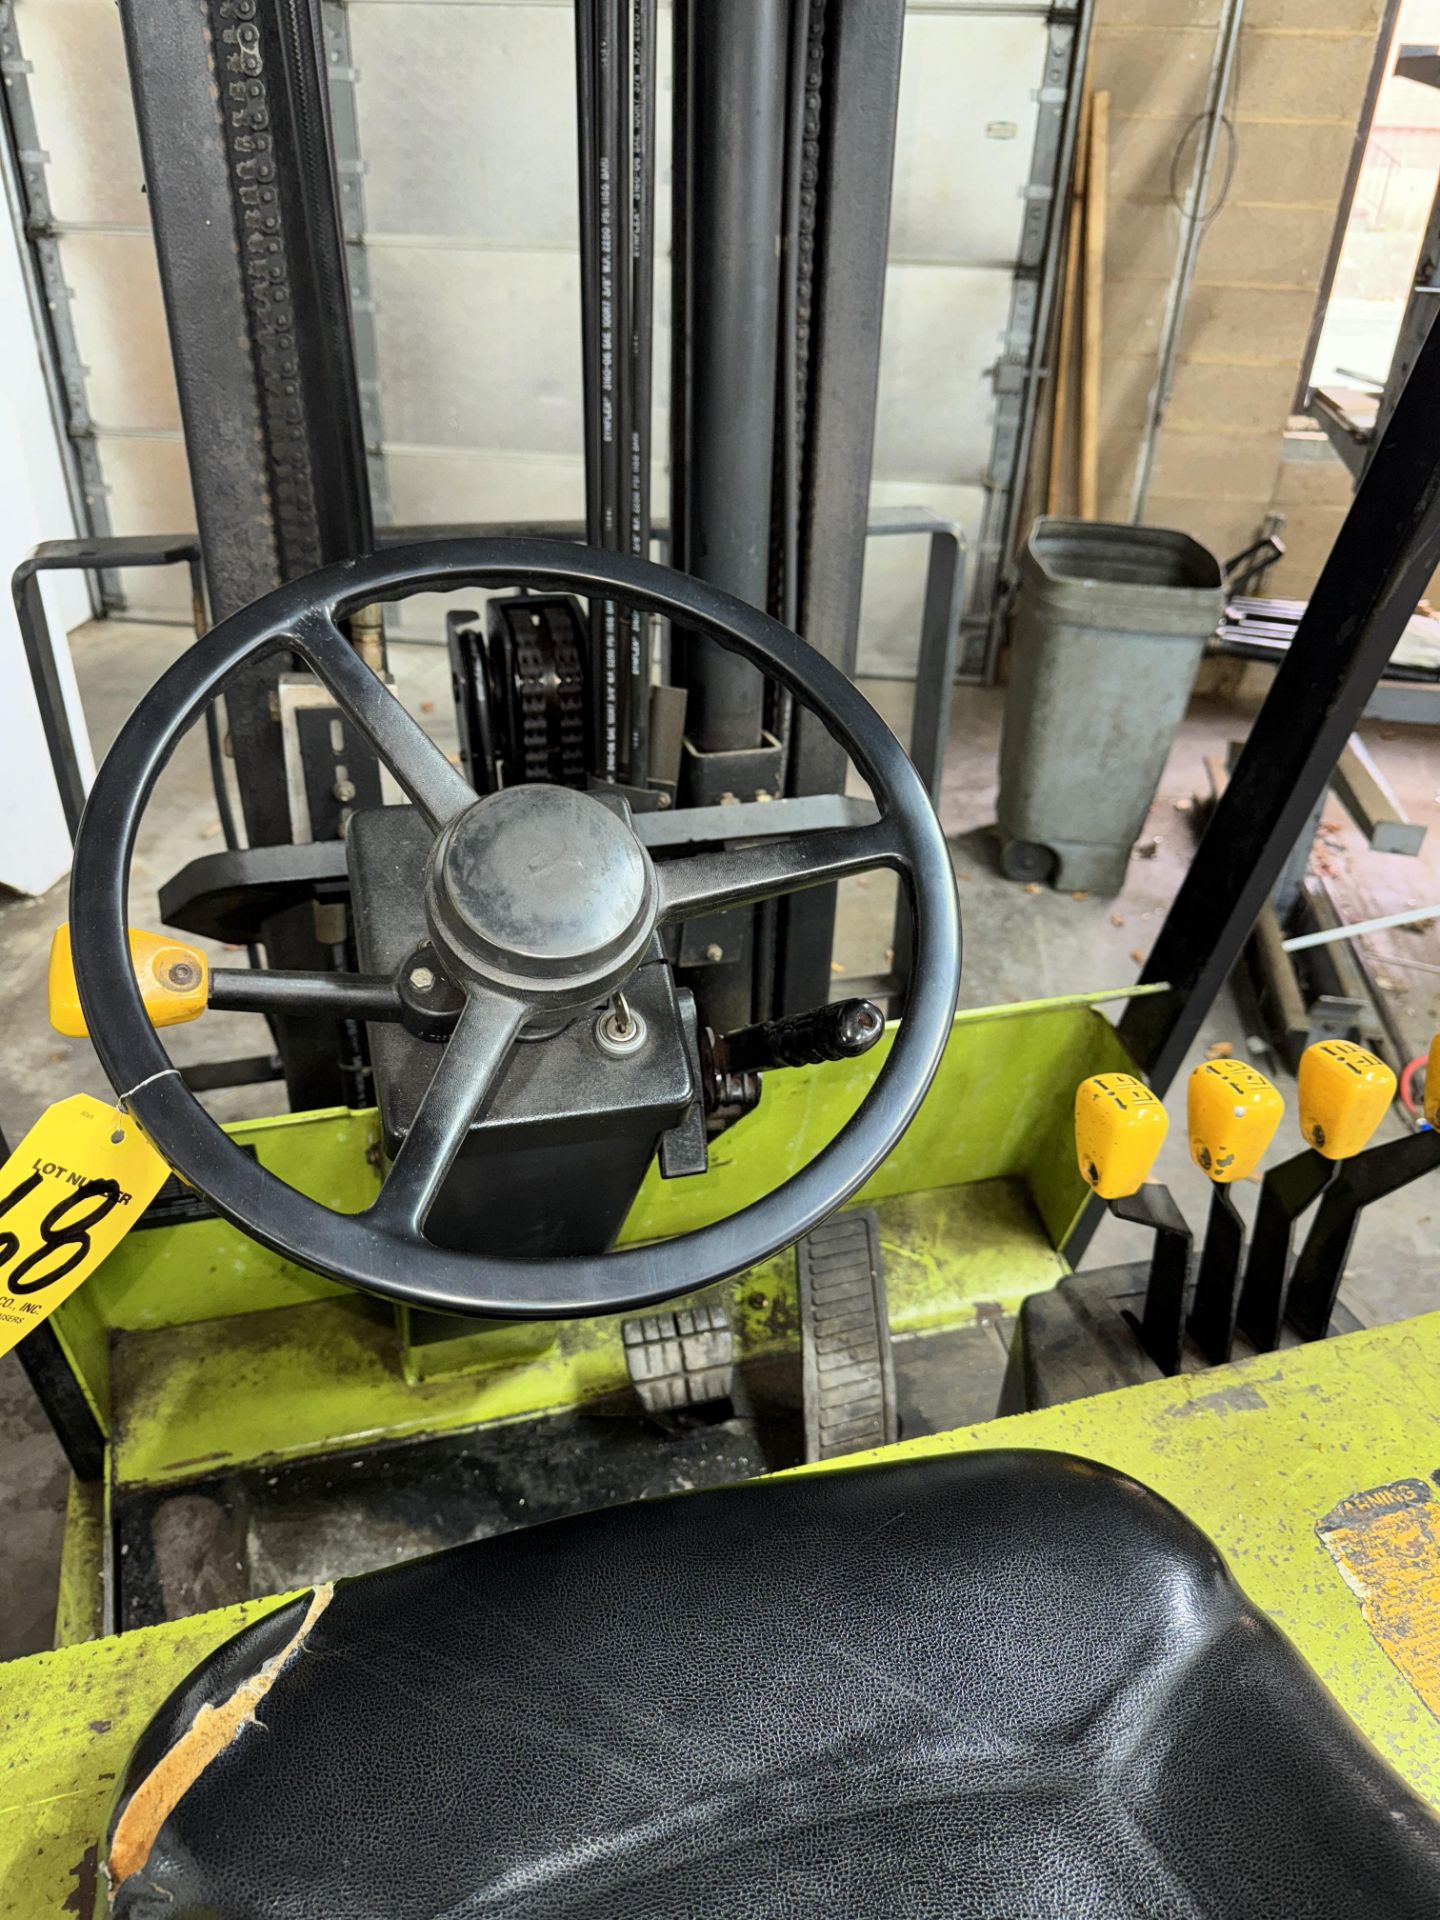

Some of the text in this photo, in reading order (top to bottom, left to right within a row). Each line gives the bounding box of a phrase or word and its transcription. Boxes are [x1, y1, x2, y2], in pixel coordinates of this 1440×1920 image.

[600, 208, 610, 224] PSI
[32, 1158, 67, 1179] LOT
[19, 1302, 42, 1315] INC.
